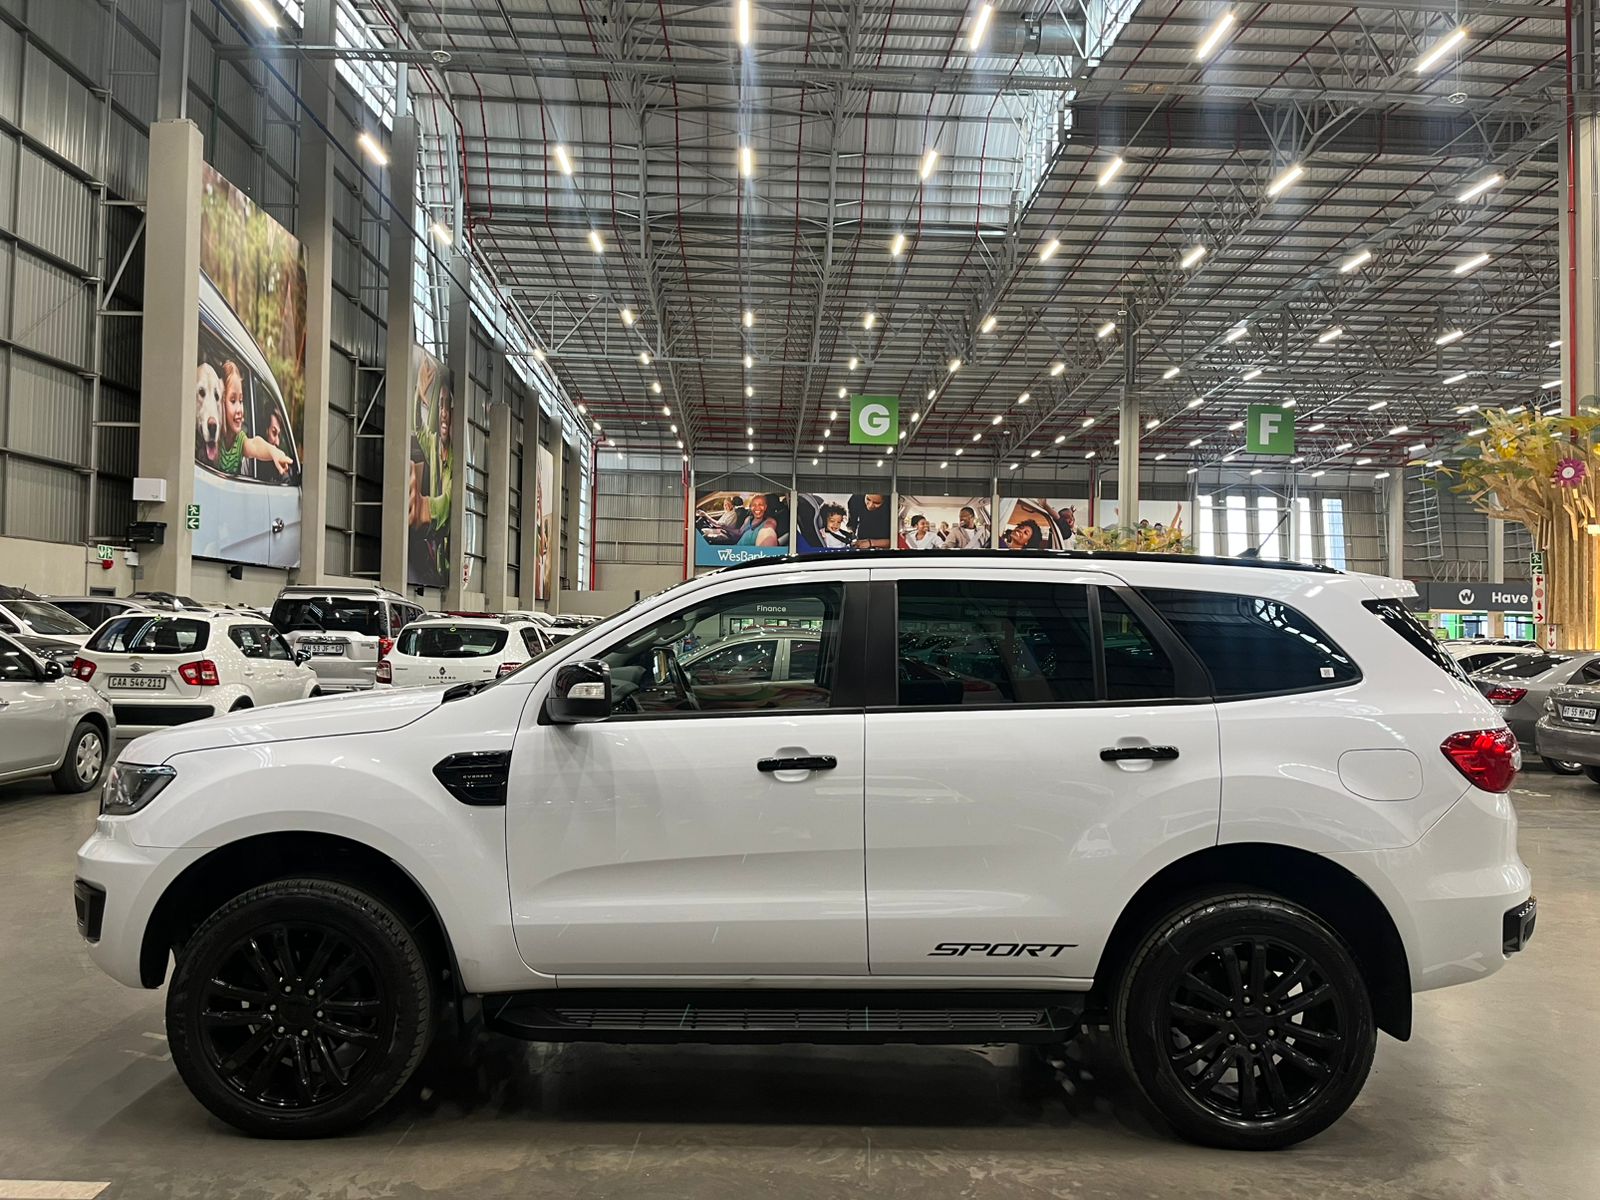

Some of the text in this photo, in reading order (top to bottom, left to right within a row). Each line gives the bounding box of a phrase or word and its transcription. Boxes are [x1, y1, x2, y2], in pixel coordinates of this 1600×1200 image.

[859, 403, 890, 436] G
[1260, 413, 1281, 445] F
[1491, 592, 1528, 604] Have
[112, 677, 161, 688] CAA 546-211
[927, 943, 1079, 957] SPORT
